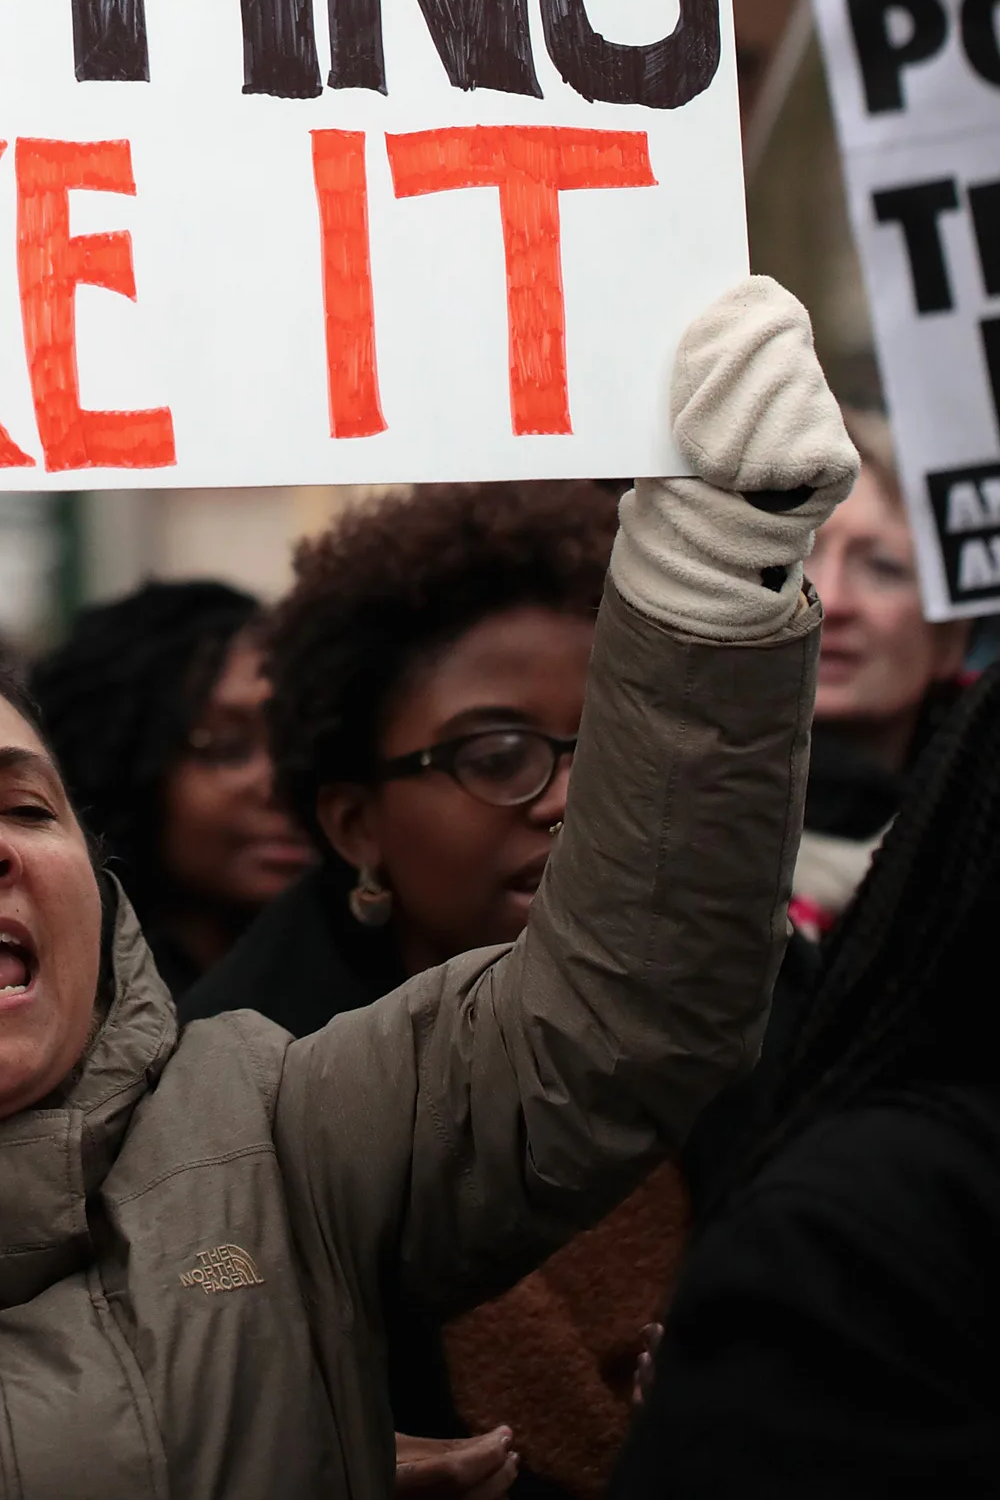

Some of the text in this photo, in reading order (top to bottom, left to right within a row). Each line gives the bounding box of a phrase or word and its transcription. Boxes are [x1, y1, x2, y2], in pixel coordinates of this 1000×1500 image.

[311, 125, 660, 439] IT
[195, 1246, 231, 1265] THE
[178, 1259, 236, 1288] NORTH
[201, 1273, 244, 1295] FACE
